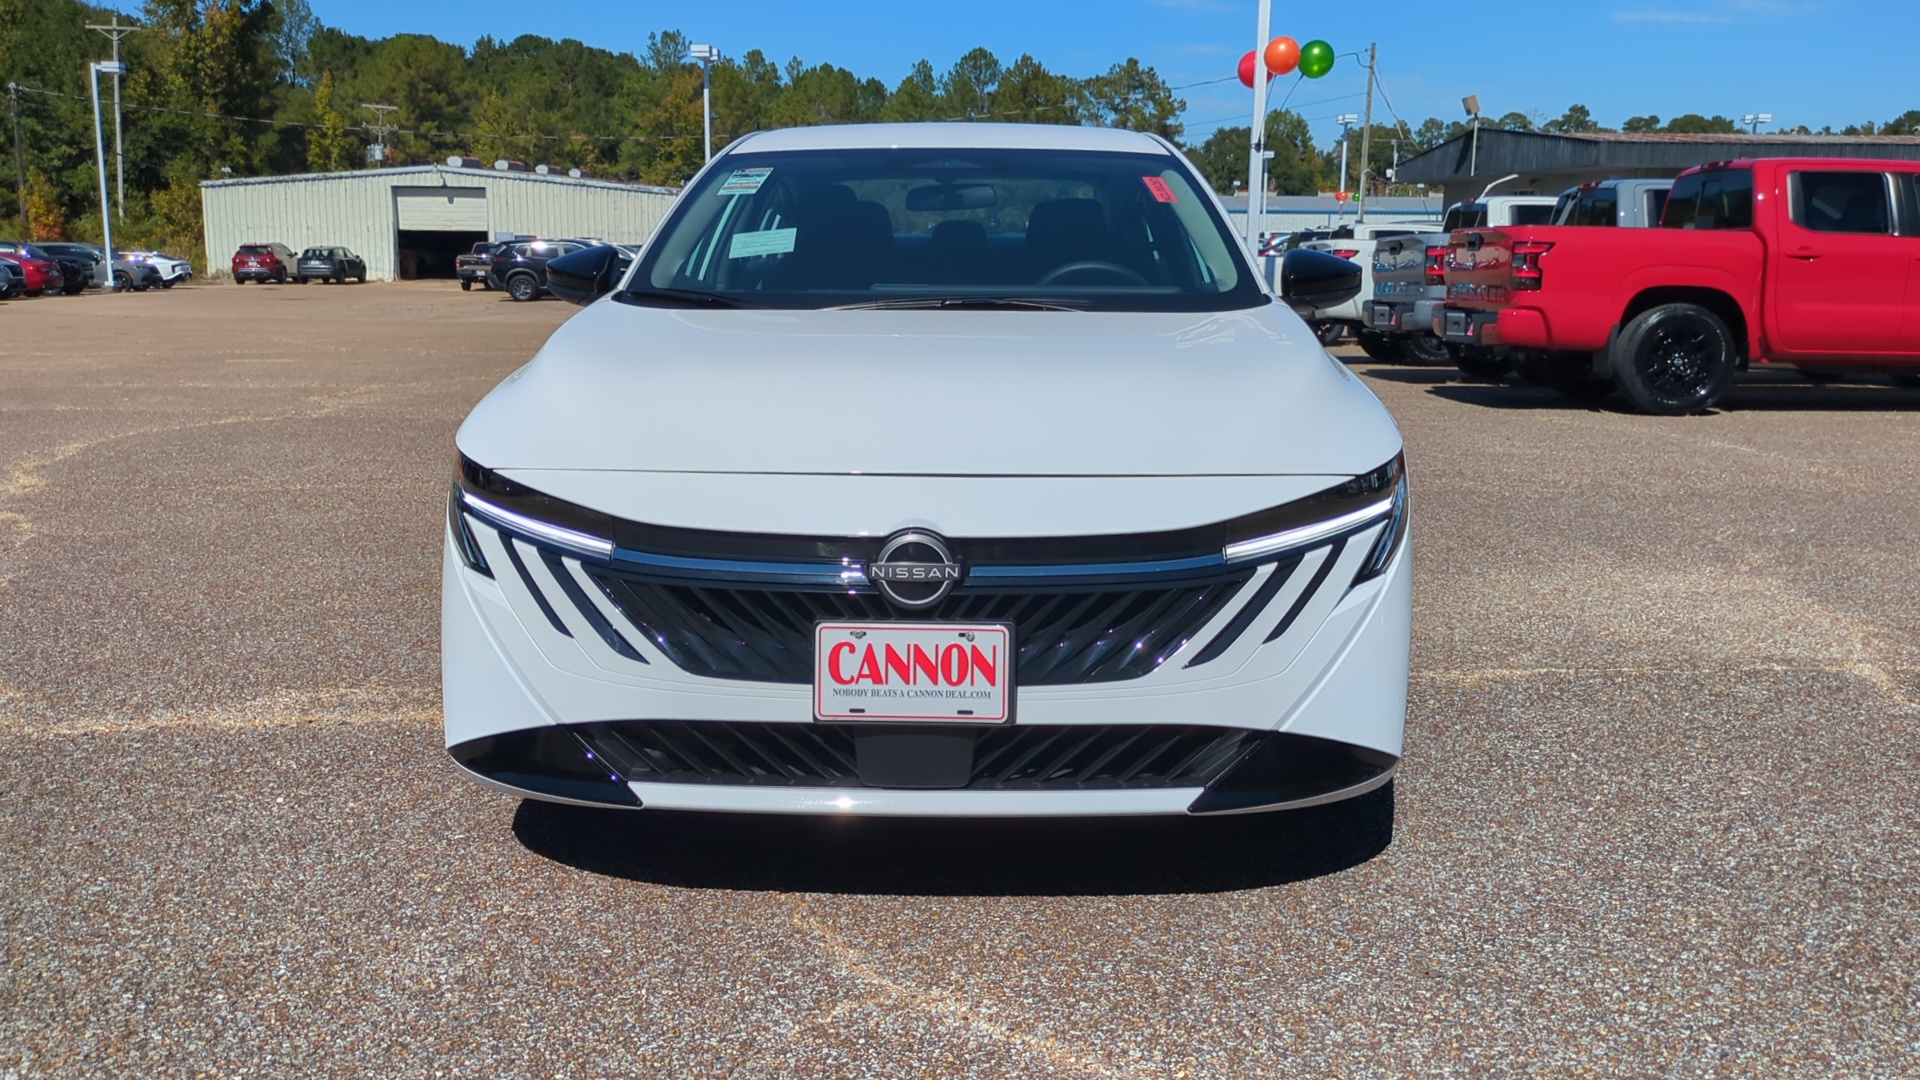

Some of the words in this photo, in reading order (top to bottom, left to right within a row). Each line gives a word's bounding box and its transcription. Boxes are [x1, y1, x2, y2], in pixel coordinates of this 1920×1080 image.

[871, 566, 959, 579] NISSAN
[828, 641, 996, 687] CANNON
[832, 688, 870, 698] NOBODY
[871, 688, 898, 698] BEATS
[898, 689, 905, 698] A
[906, 689, 944, 699] CANNON
[945, 689, 991, 699] DEAL.COM
